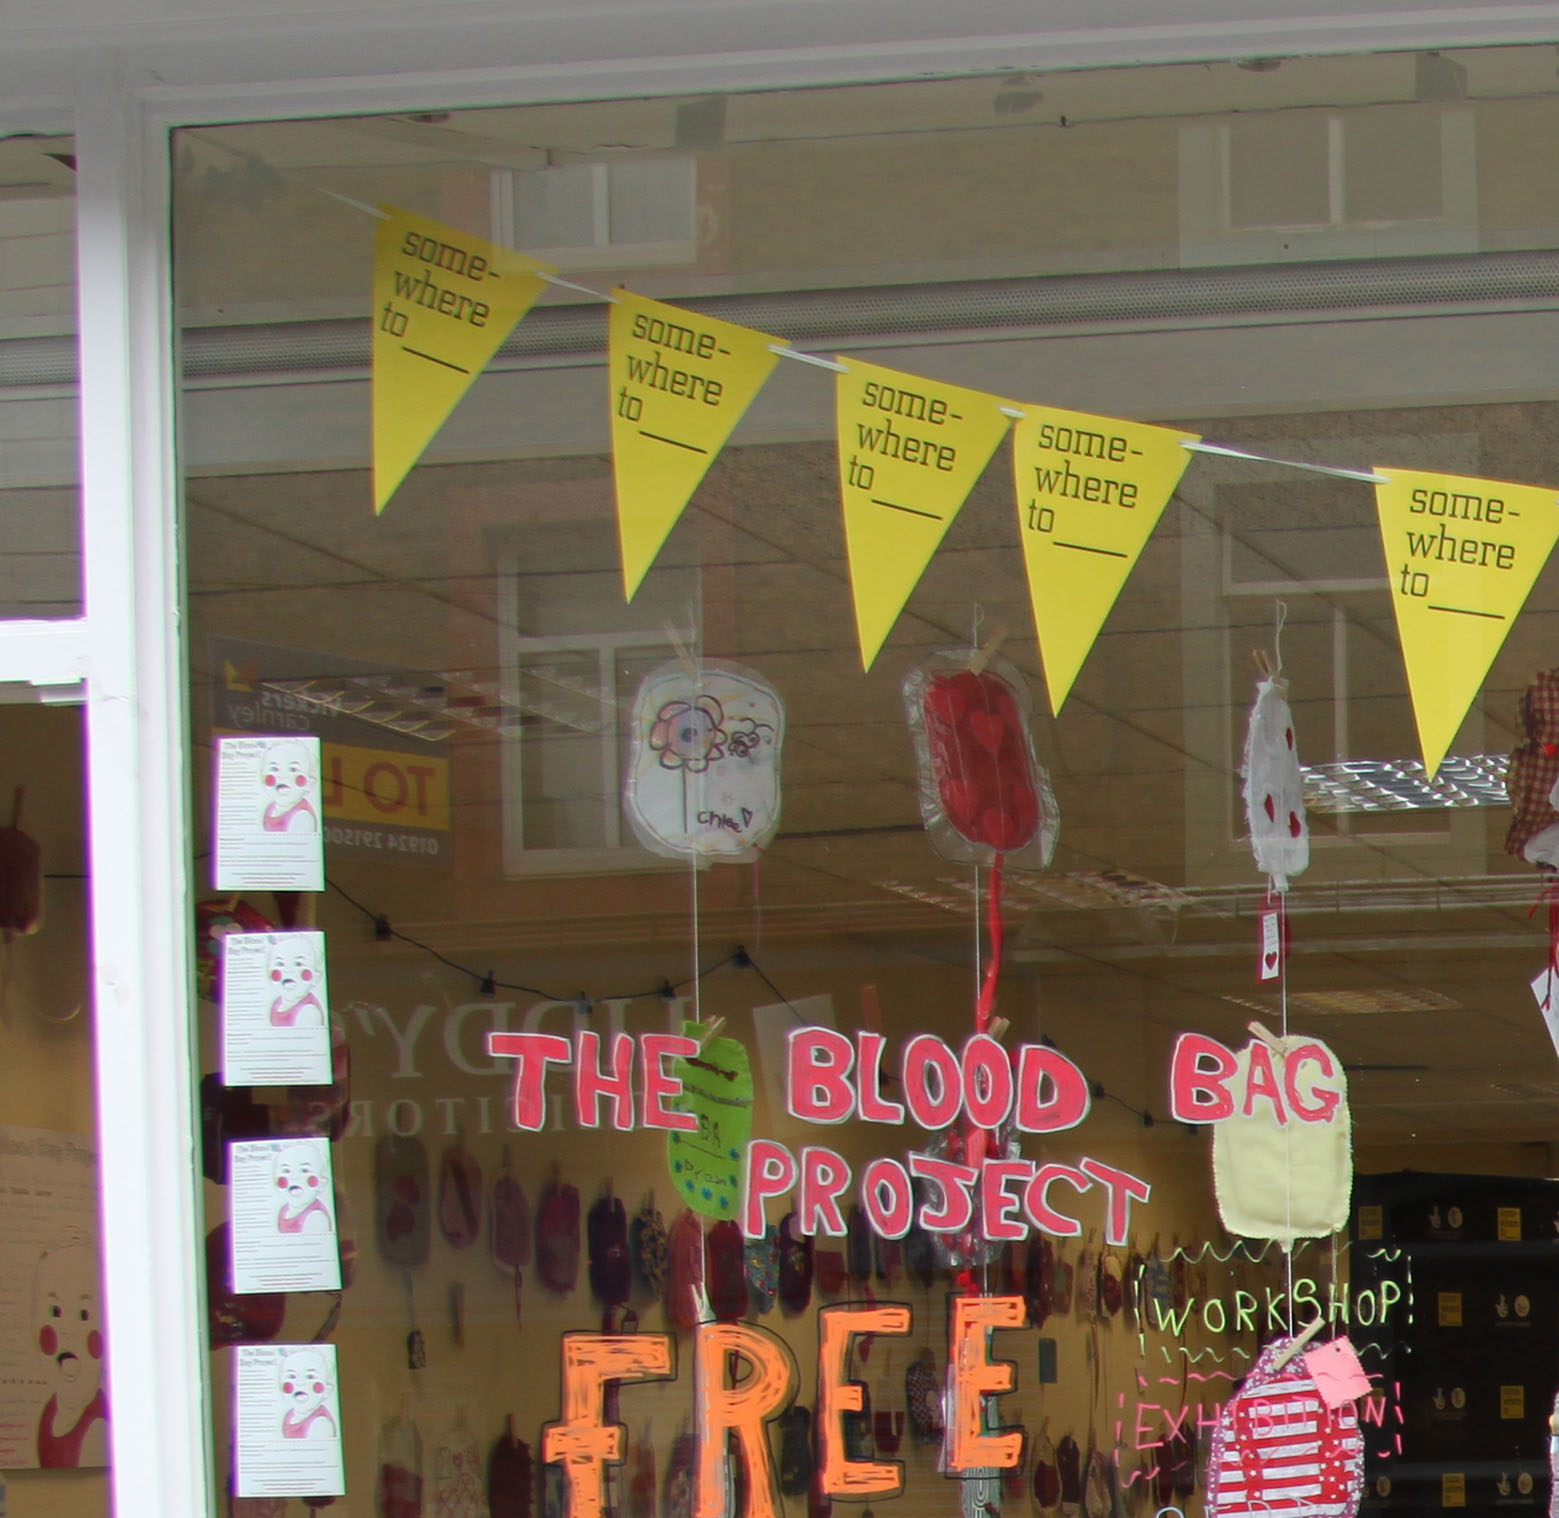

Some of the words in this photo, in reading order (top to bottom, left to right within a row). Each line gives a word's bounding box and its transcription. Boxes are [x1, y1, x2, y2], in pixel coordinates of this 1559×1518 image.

[403, 229, 500, 281] some-
[394, 268, 490, 328] where
[632, 312, 730, 360] some-
[626, 354, 722, 406] where
[862, 382, 963, 425] some-
[856, 422, 956, 473] where
[1039, 423, 1143, 464] some-
[1034, 462, 1138, 509] where
[1410, 487, 1521, 527] some-
[1406, 526, 1515, 571] where
[487, 1031, 701, 1133] THE
[787, 1026, 1092, 1134] BLOOD
[1171, 1031, 1343, 1126] BAG
[741, 1138, 1152, 1247] PROJECT
[1154, 1277, 1401, 1338] WORKSHOP
